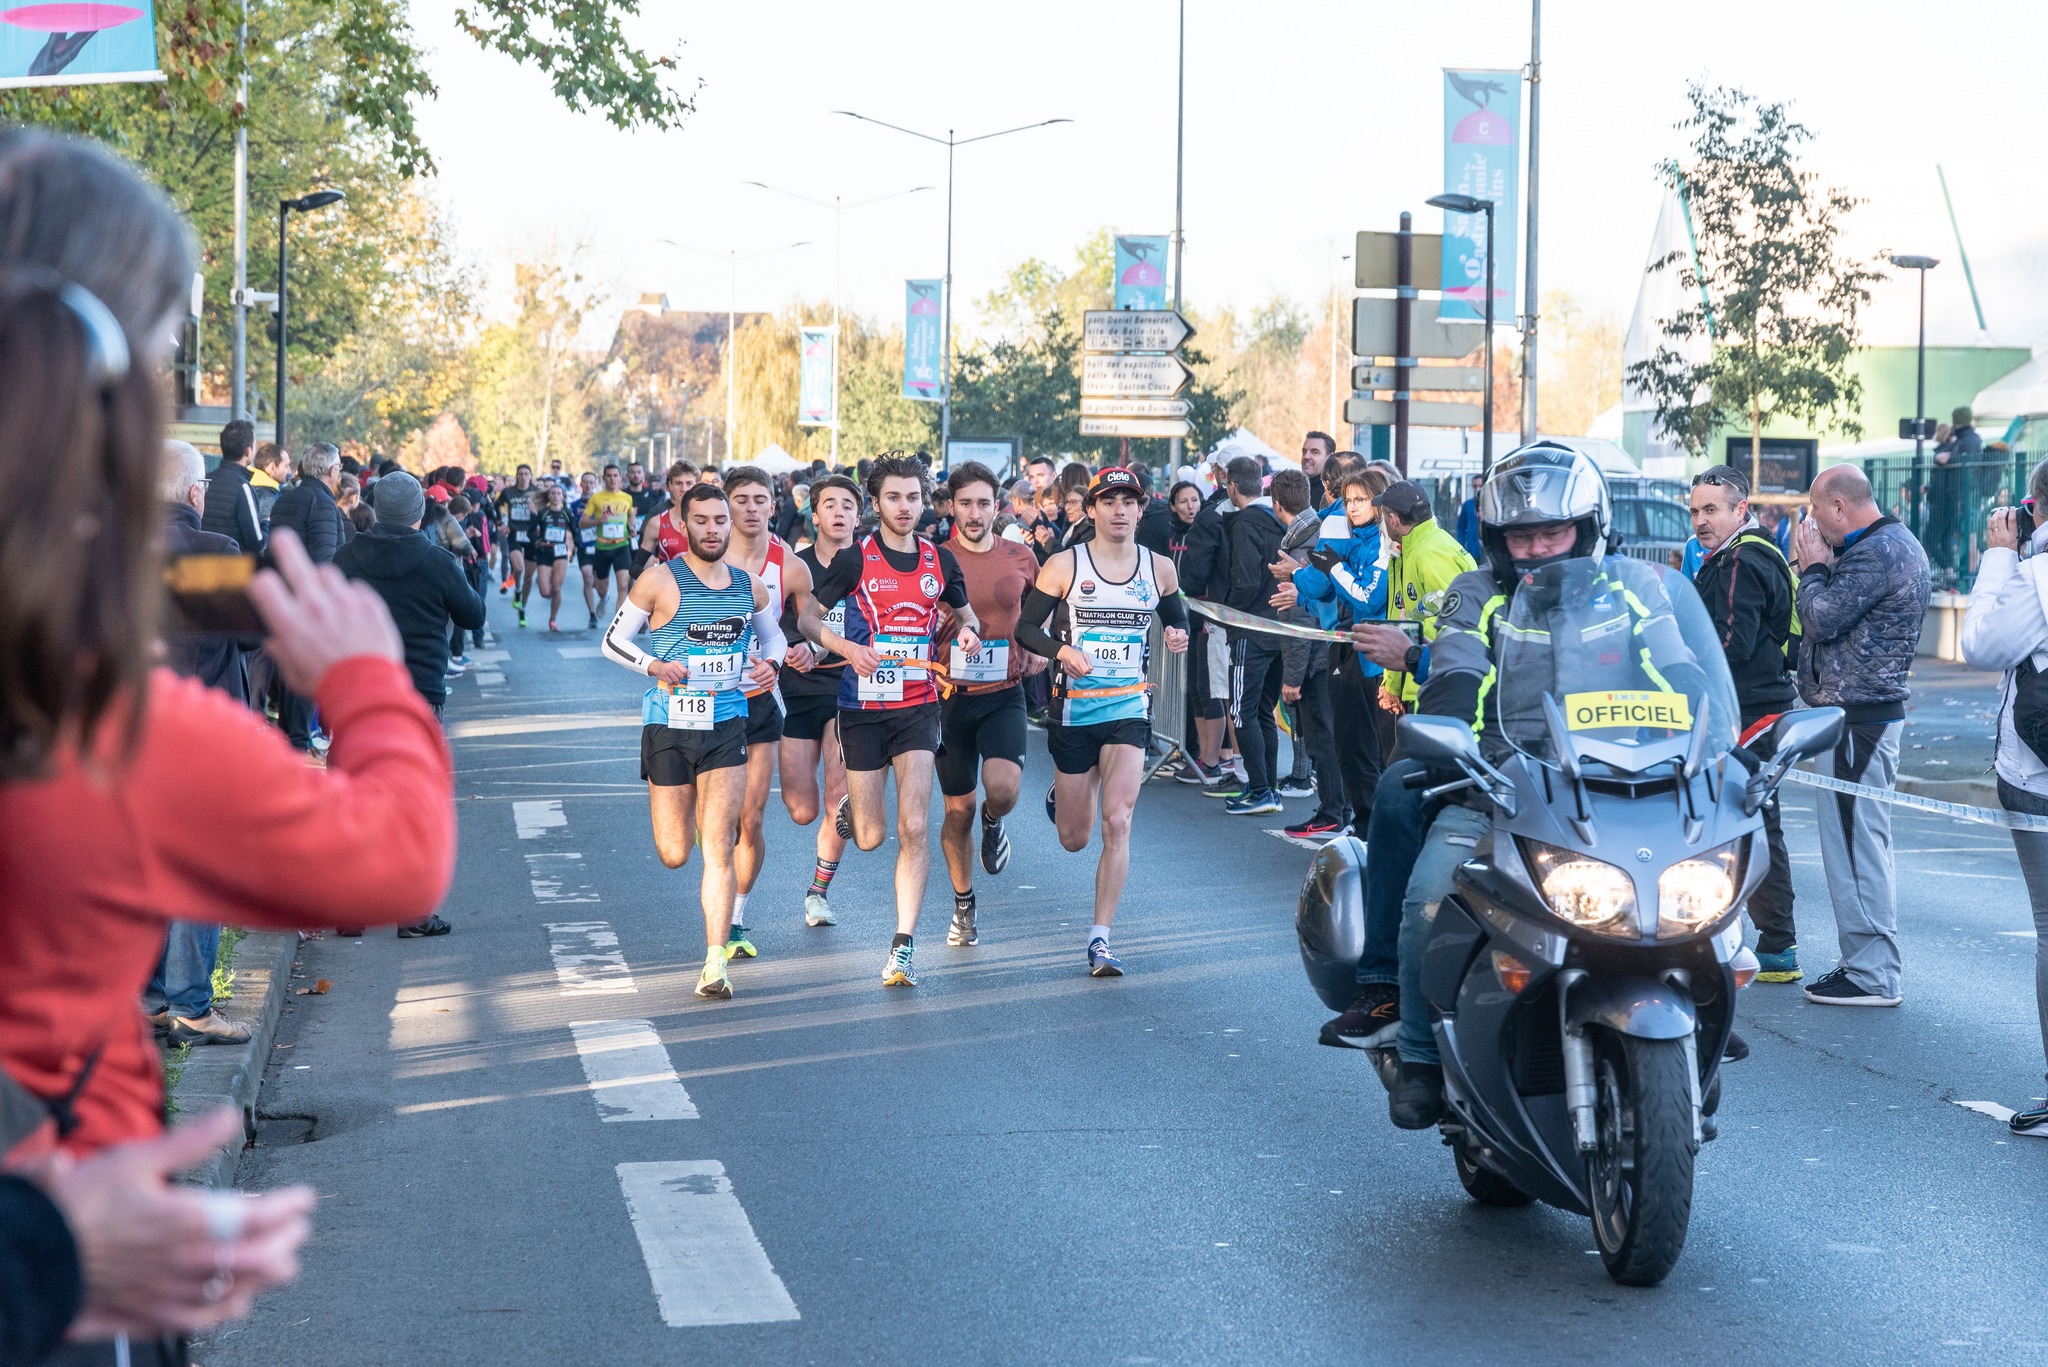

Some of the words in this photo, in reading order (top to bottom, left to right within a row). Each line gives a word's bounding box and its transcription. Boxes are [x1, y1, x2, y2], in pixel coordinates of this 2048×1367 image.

[1453, 183, 1470, 238] San
[1088, 316, 1105, 326] parc
[1107, 315, 1132, 325] Daniel
[1134, 315, 1173, 325] Bernardet
[1088, 327, 1105, 336] site
[1108, 327, 1119, 336] de
[1122, 326, 1165, 336] Belle-Isle
[1087, 360, 1104, 368] hall
[1106, 360, 1120, 368] des
[1124, 360, 1172, 370] expositions
[1087, 371, 1107, 380] salle
[1112, 371, 1126, 380] des
[1118, 382, 1146, 391] Gaston
[1085, 423, 1119, 433] bowling
[1078, 611, 1116, 619] TRIATHLON
[1116, 612, 1135, 620] CLUB
[690, 622, 733, 632] Running
[706, 631, 738, 640] Expert
[965, 648, 994, 664] 89.1
[1094, 644, 1130, 660] 108.1
[700, 654, 734, 673] 118.1
[677, 698, 706, 713] 118
[1576, 705, 1682, 724] OFFICIEL
